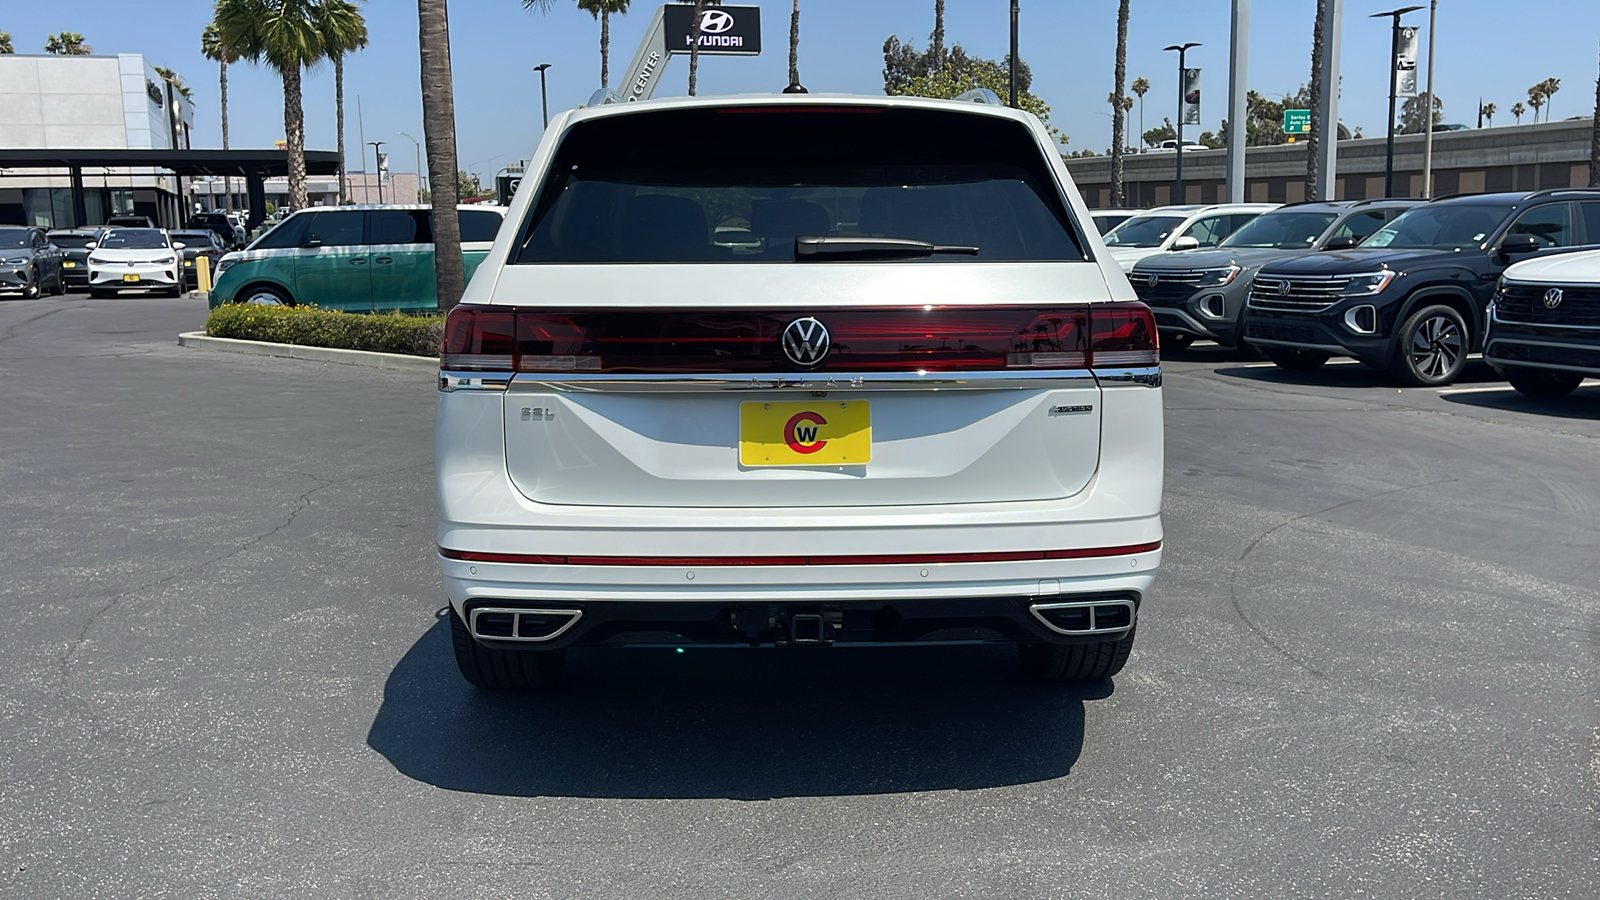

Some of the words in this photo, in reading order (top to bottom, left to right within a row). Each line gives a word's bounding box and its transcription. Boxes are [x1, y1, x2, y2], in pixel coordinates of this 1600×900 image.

[686, 34, 743, 47] HYUNDAI
[633, 51, 661, 95] CENTER
[783, 317, 830, 366] VW
[748, 376, 864, 388] ATLAS
[521, 407, 555, 418] SEL
